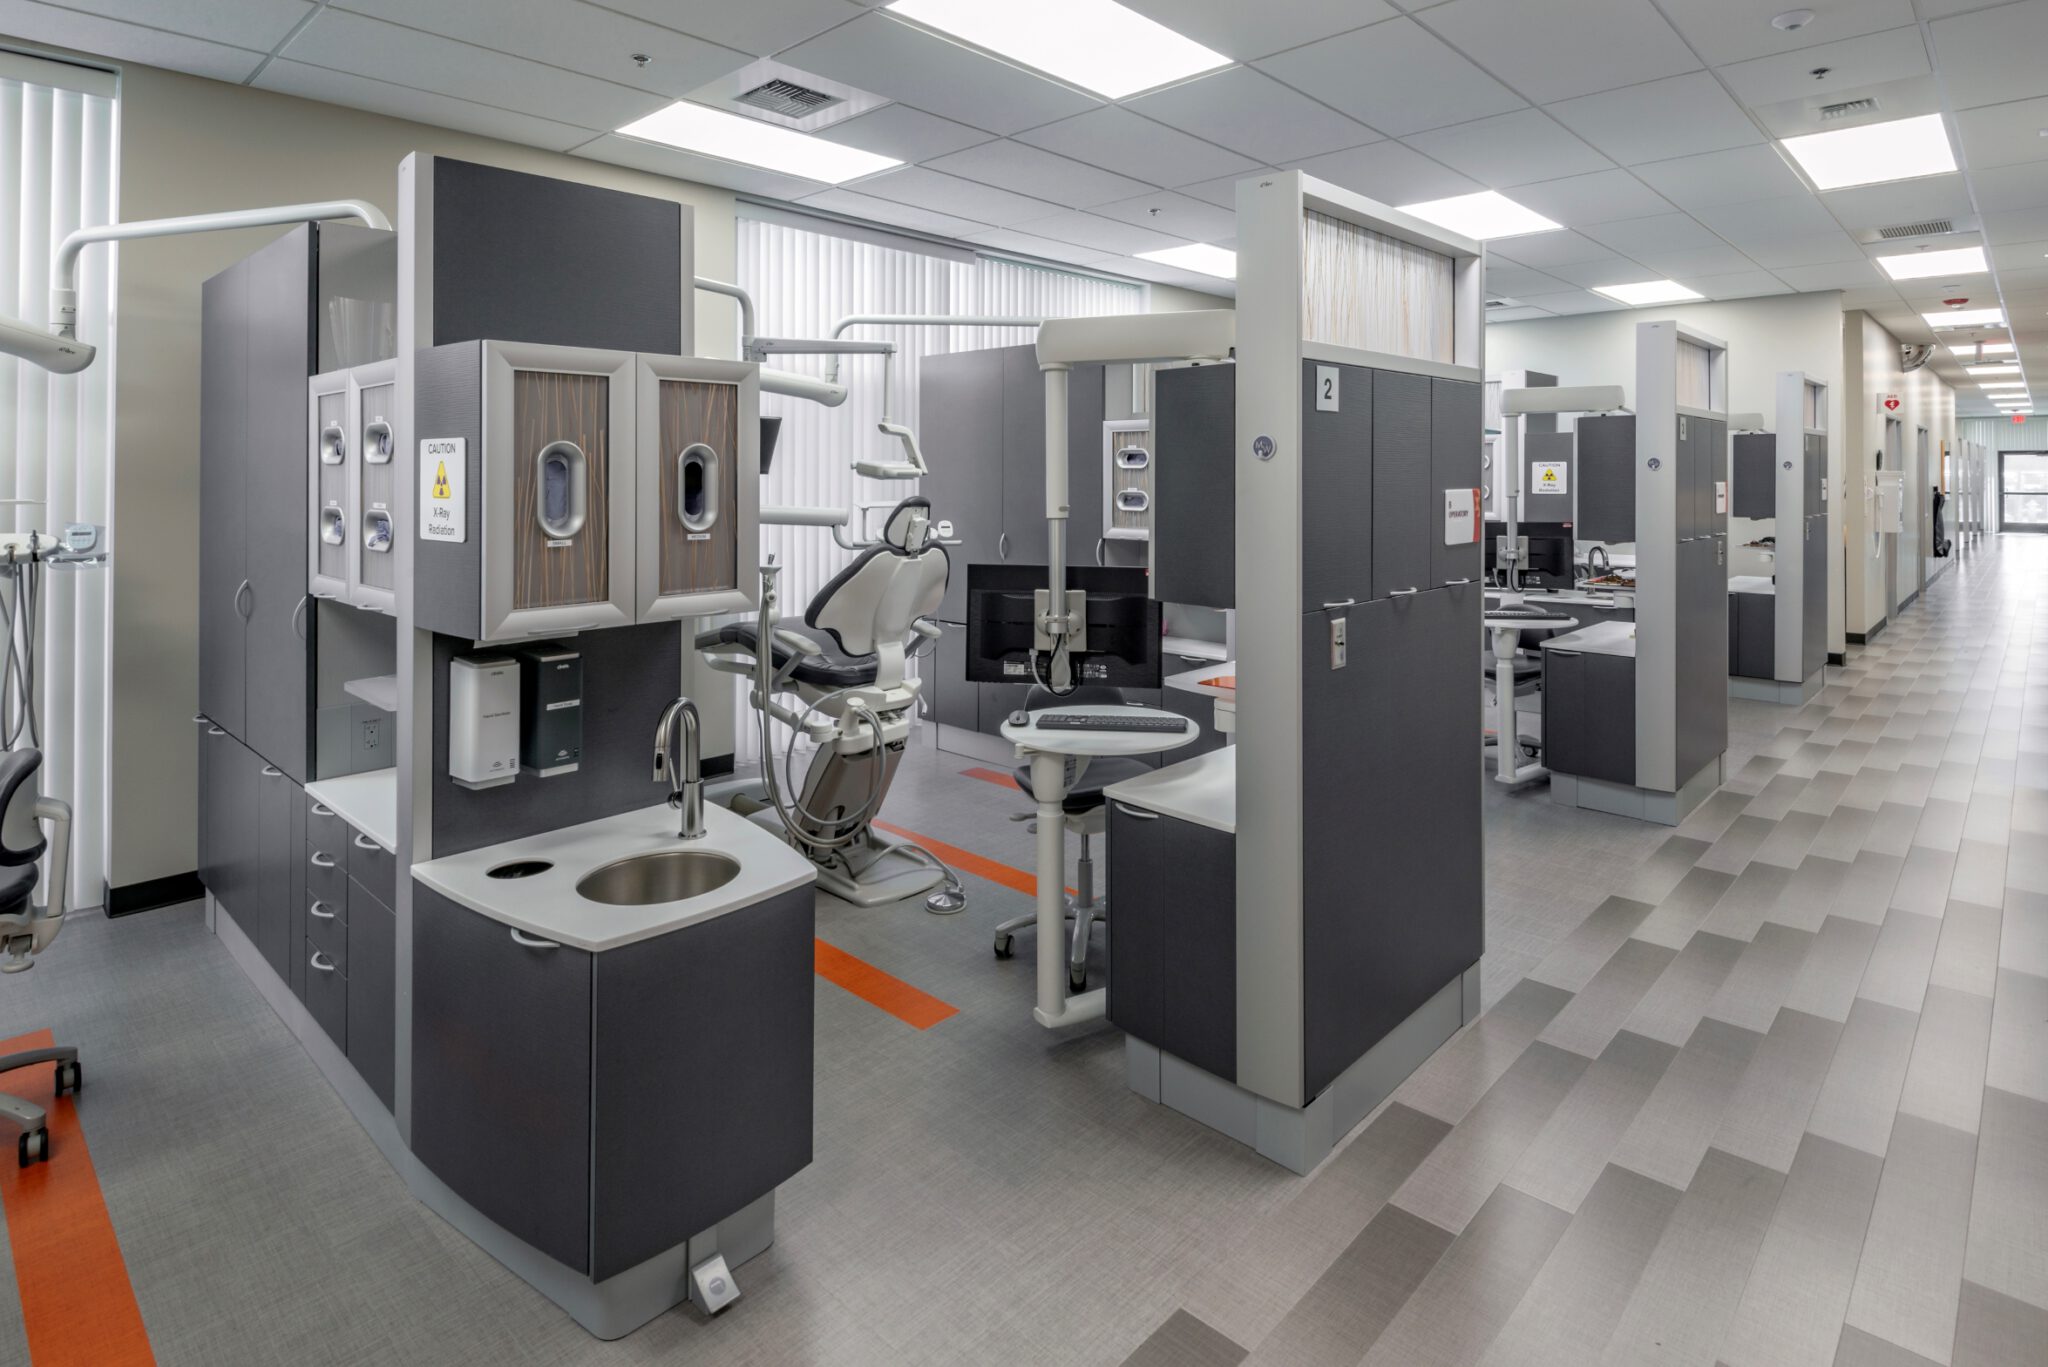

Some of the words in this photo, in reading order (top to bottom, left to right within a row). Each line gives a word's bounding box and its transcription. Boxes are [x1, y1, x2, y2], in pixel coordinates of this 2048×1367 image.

[1324, 378, 1332, 400] 2
[428, 443, 456, 454] CAUTION
[433, 507, 451, 520] X-Ray
[428, 523, 455, 536] Radiation
